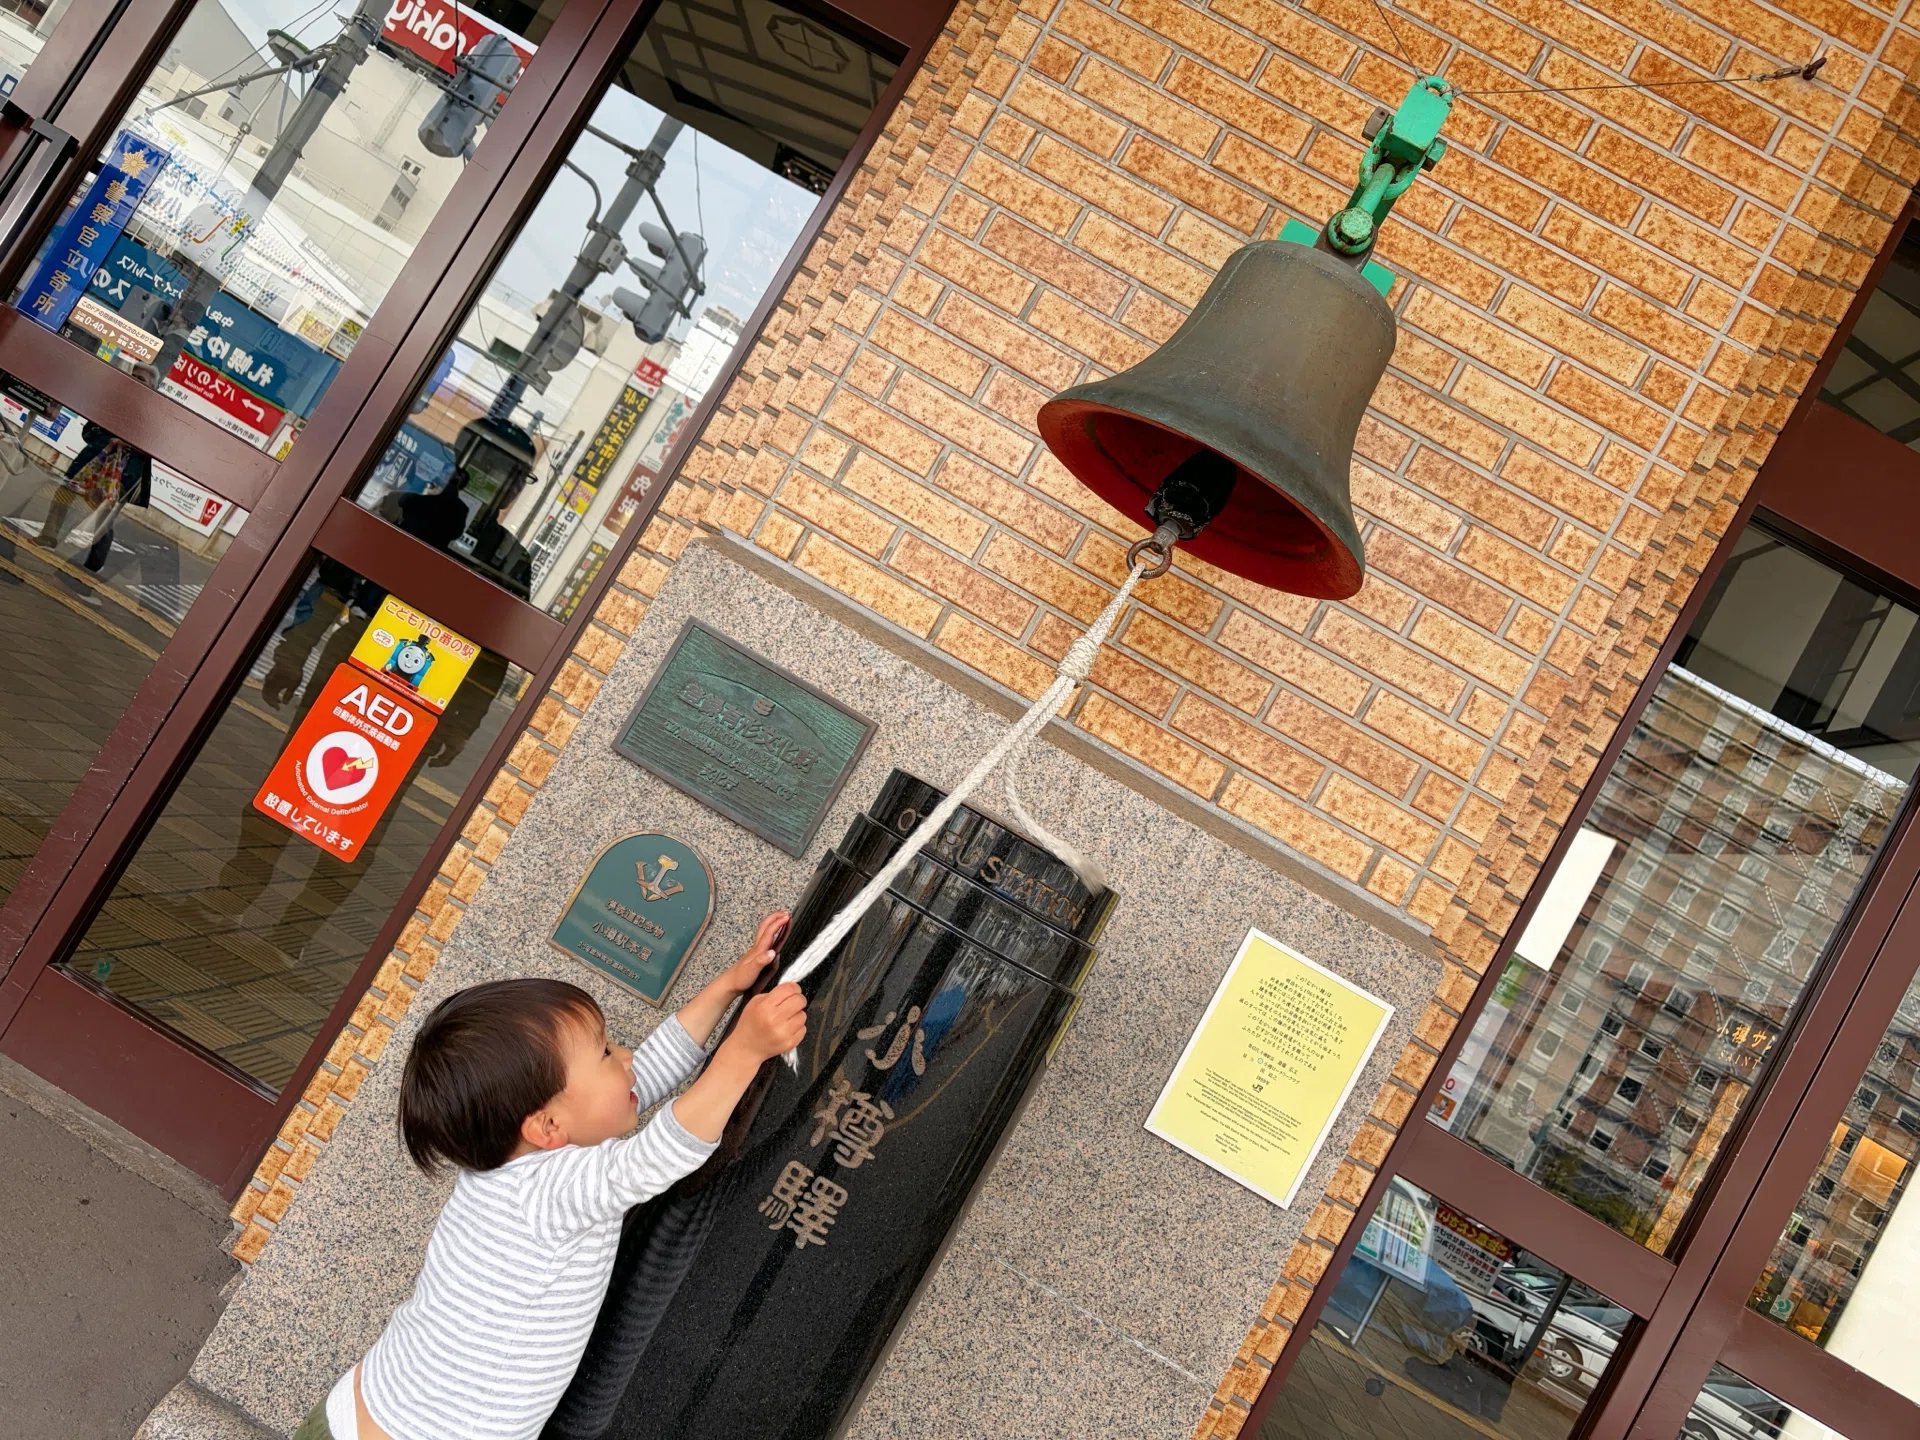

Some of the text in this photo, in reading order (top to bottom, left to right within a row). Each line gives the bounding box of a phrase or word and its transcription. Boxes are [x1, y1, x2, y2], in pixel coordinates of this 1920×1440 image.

[31, 178, 129, 316] 警察官立寄所
[383, 599, 475, 659] こども110番の駅
[331, 706, 401, 751] 自動体外式除細動器
[340, 683, 415, 737] AED
[293, 759, 369, 816] Automated External Defibrillator
[262, 791, 355, 853] 設置しています
[893, 804, 1086, 931] OARU STATION
[590, 917, 654, 964] 小樽駅本屋
[1251, 1082, 1264, 1092] JR
